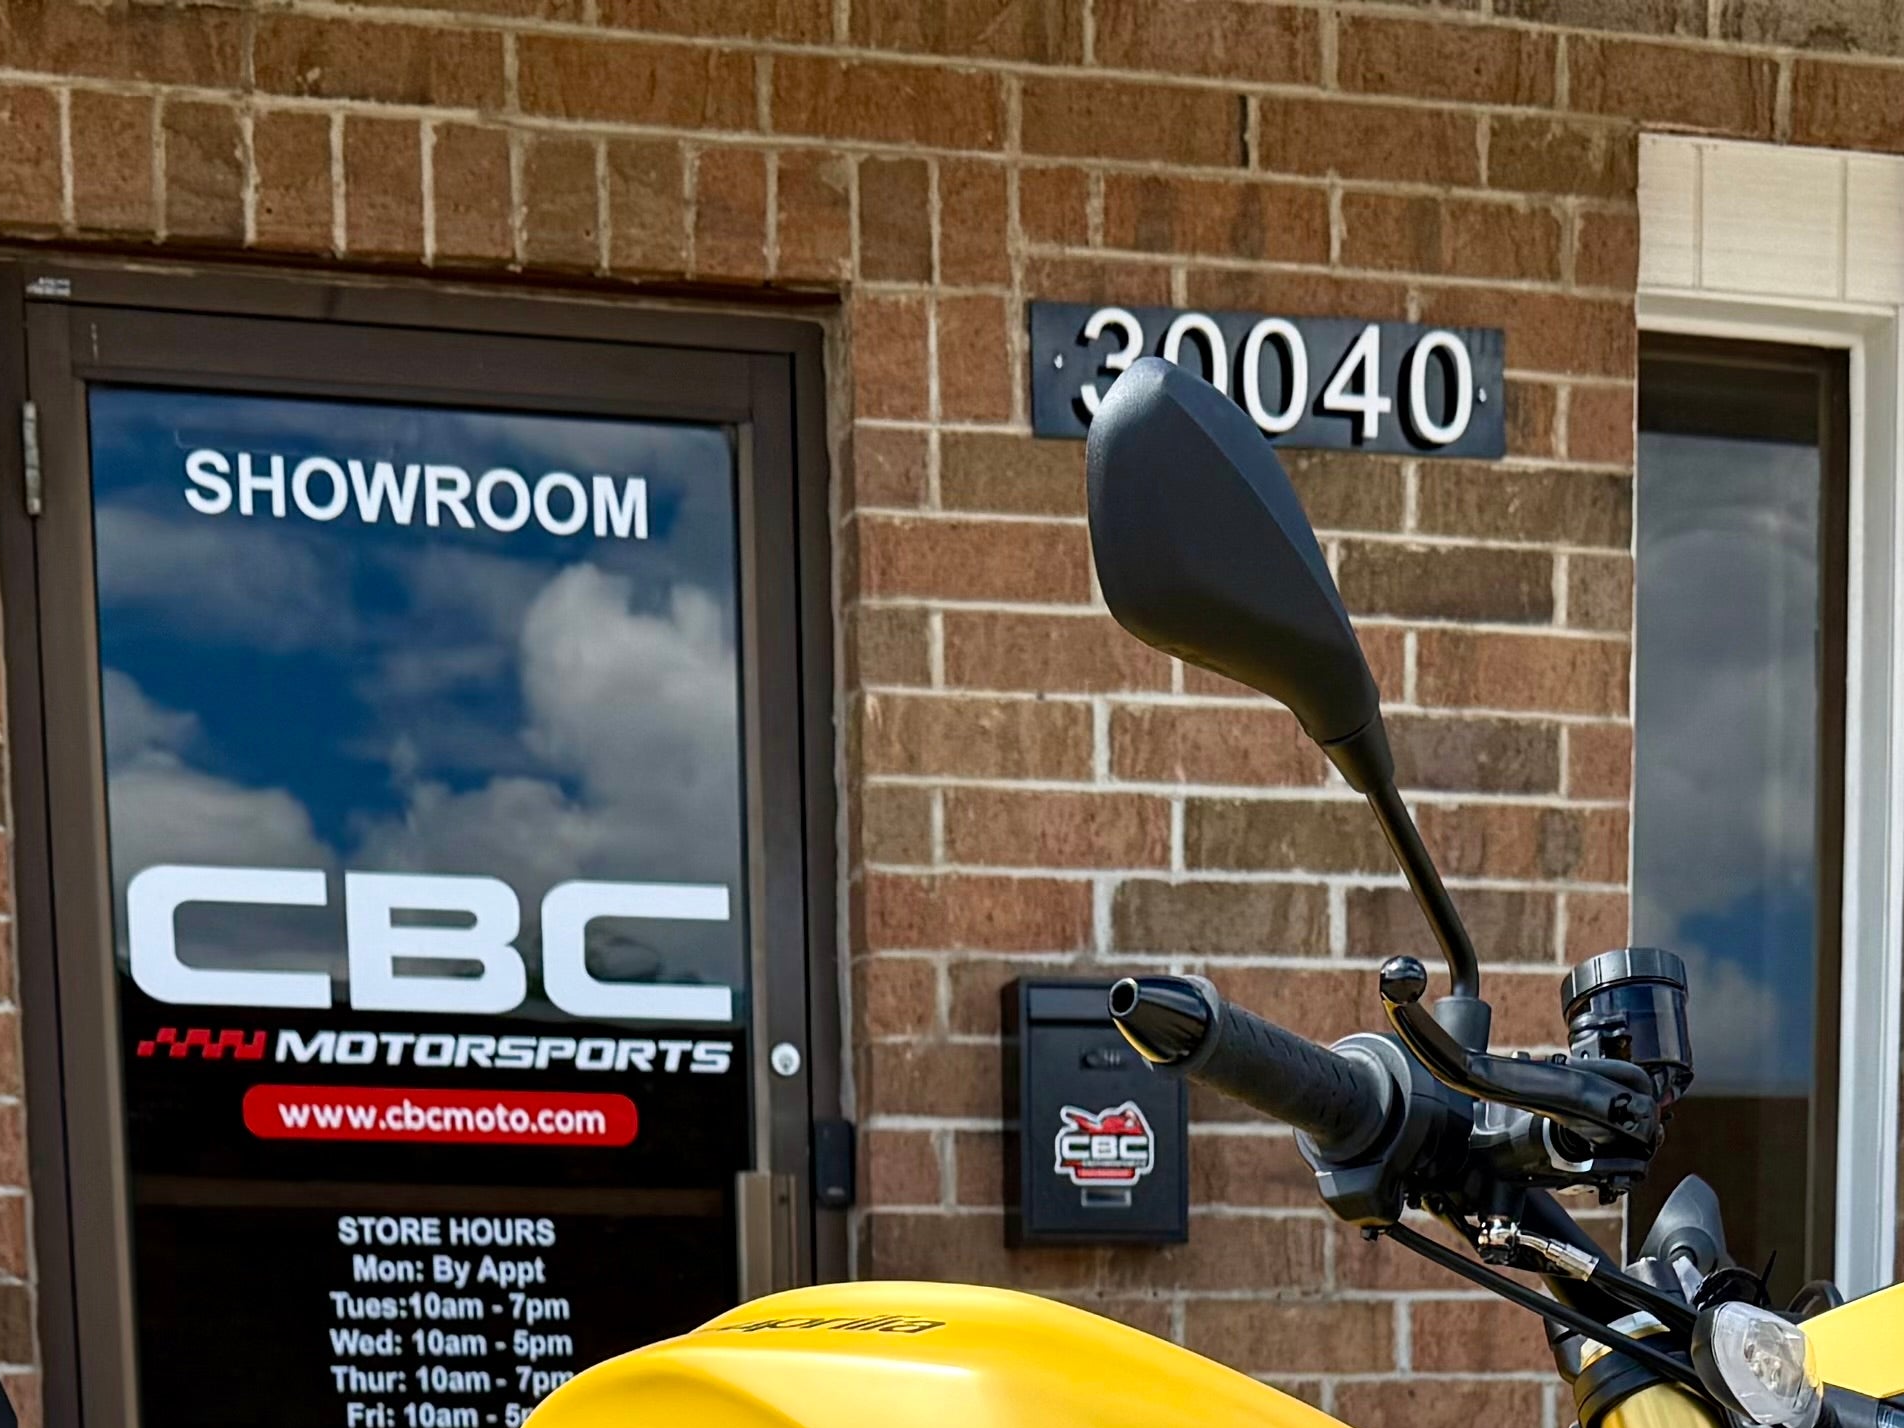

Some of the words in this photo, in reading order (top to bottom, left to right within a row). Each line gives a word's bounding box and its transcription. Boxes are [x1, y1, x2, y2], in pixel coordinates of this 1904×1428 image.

[184, 447, 649, 540] SHOWROOM
[127, 864, 733, 1020] CBC
[275, 1028, 733, 1074] MOTORSPORTS
[276, 1098, 607, 1136] www.cbcmoto.com
[1061, 1135, 1149, 1160] CBC
[338, 1216, 442, 1246] STORE
[449, 1218, 556, 1247] HOURS
[352, 1254, 424, 1283] Mon:
[432, 1255, 471, 1289] By
[477, 1255, 546, 1289] Appt
[509, 1292, 570, 1326] 7pm
[329, 1328, 403, 1357] Wed:
[411, 1328, 487, 1357] 10am
[513, 1329, 574, 1362] 5pm
[329, 1365, 407, 1393] Thur:
[415, 1365, 492, 1394] 10am
